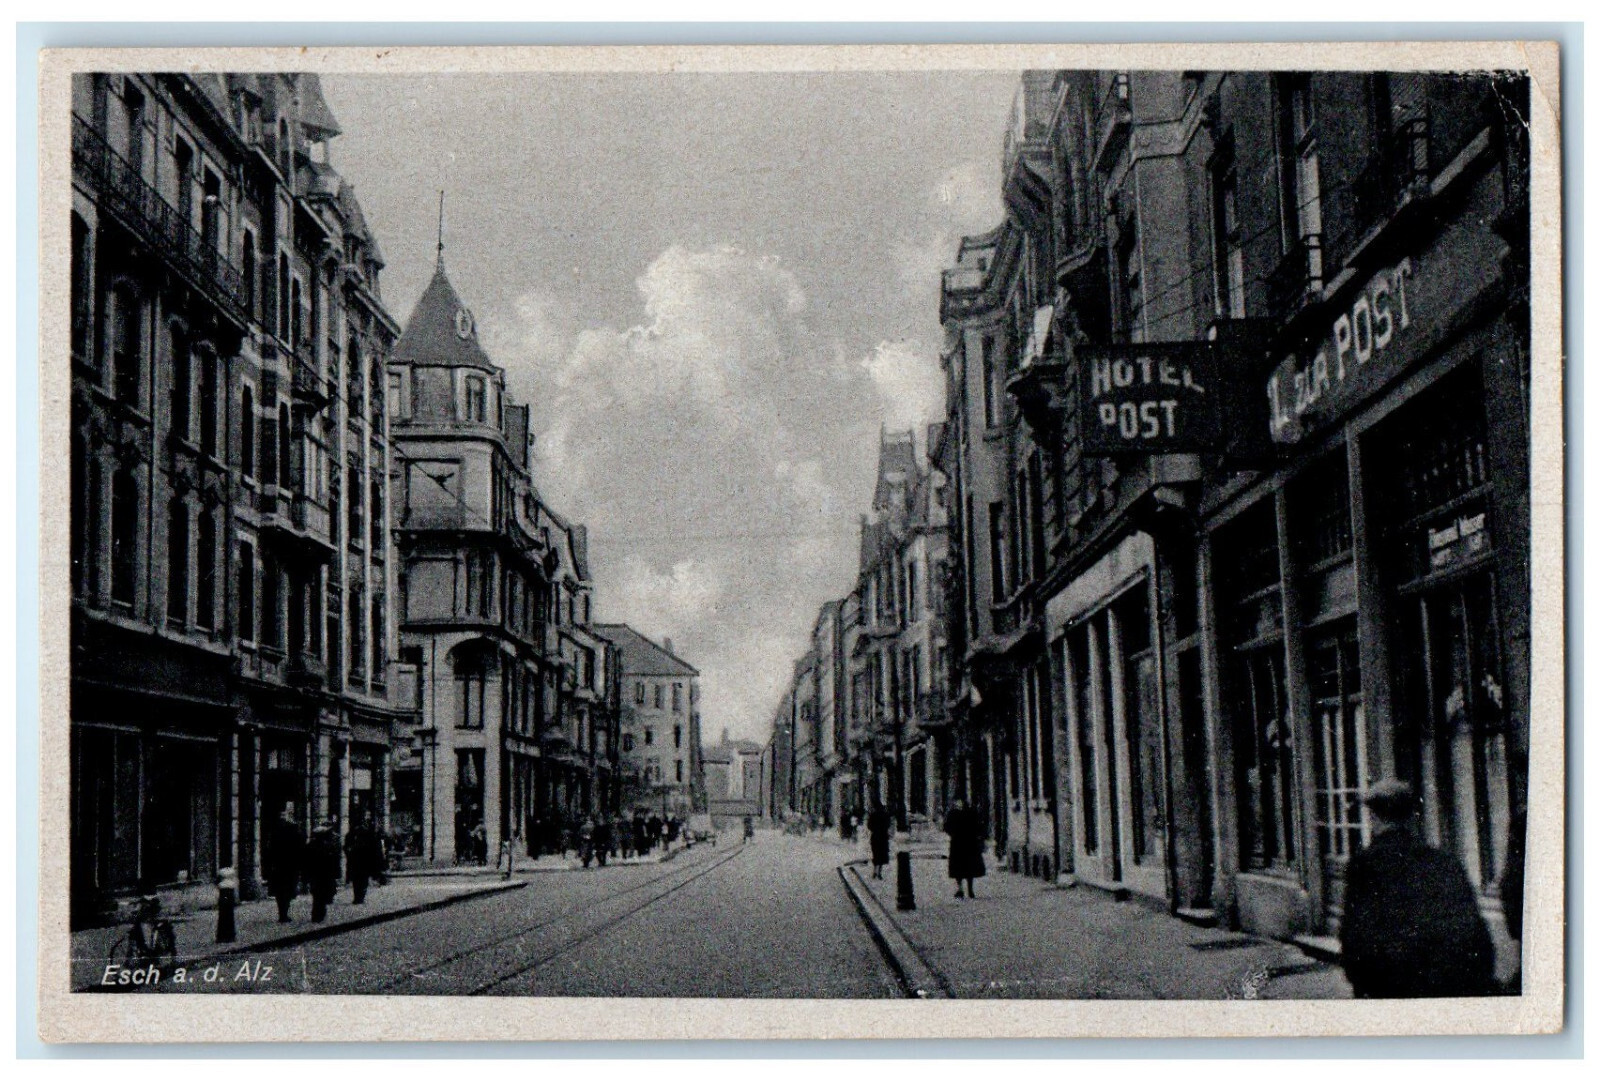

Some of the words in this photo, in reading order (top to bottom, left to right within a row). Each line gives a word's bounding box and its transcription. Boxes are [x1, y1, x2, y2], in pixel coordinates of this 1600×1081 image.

[1333, 256, 1412, 381] POST
[1091, 357, 1205, 397] HOTEL
[1099, 400, 1178, 439] POST
